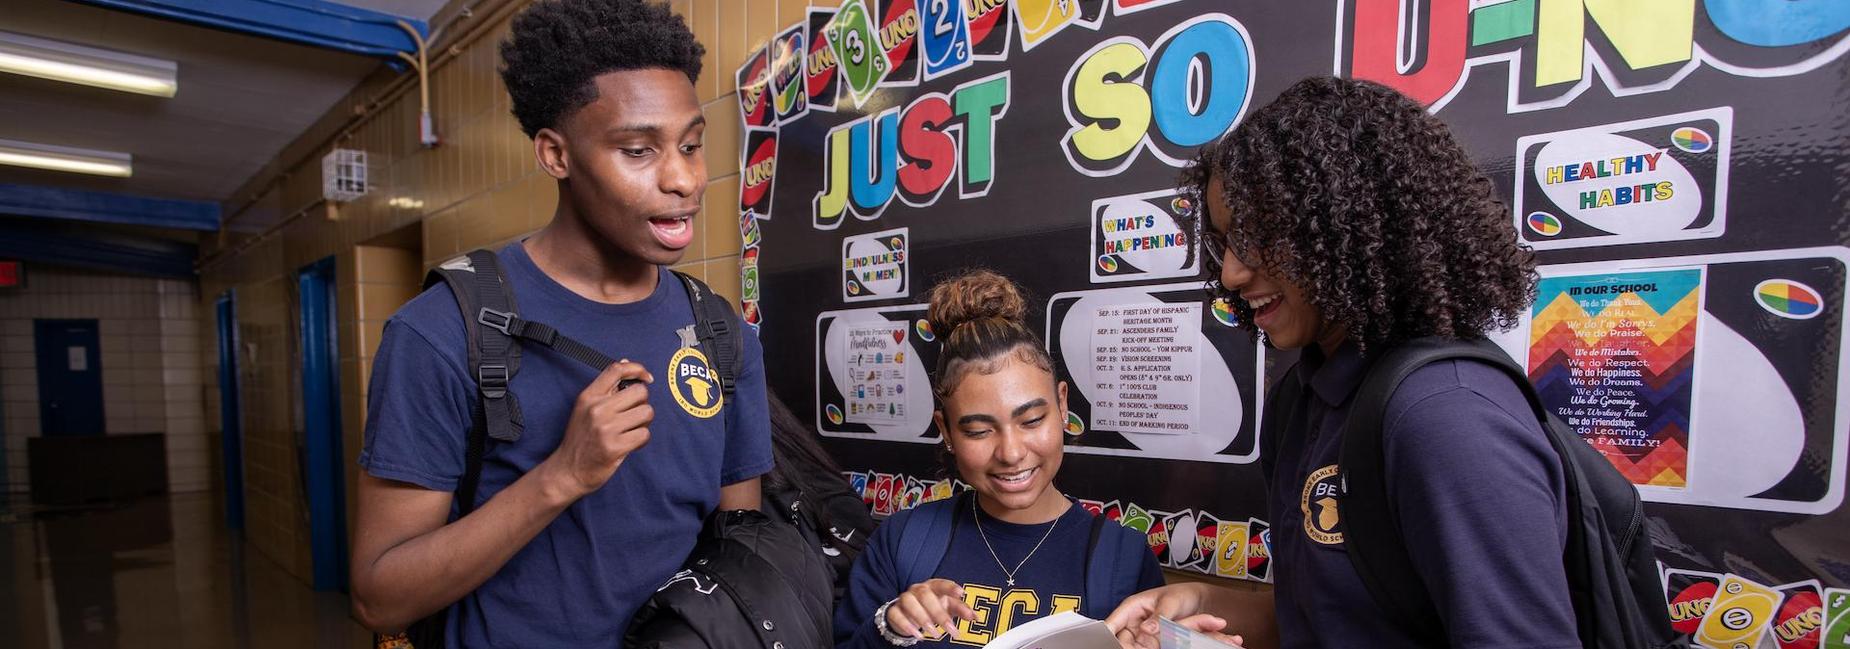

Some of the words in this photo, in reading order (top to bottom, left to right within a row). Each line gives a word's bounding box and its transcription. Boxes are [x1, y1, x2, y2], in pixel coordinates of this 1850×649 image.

[931, 0, 954, 37] 2
[878, 8, 918, 53] UNO
[845, 29, 865, 66] 3
[955, 40, 966, 60] 2
[808, 46, 837, 78] UN
[1072, 18, 1251, 161] SO
[816, 75, 1010, 221] JUST
[743, 155, 776, 188] UNO
[1546, 151, 1662, 185] HEALTHY
[1579, 181, 1674, 211] HABITS
[1104, 214, 1155, 233] WHAT'S
[1105, 232, 1185, 255] HAPPENING
[846, 251, 904, 269] MINDFULNESS
[863, 267, 899, 282] MOMENT
[1584, 285, 1608, 295] OUR
[1610, 283, 1658, 294] SCHOOL
[1567, 320, 1581, 329] We
[1584, 320, 1597, 329] do
[1618, 318, 1656, 331] Sorrys.
[1575, 330, 1591, 338] We
[1610, 329, 1646, 337] Praise.
[1589, 348, 1599, 356] do
[1600, 347, 1642, 356] Mistakes.
[1567, 358, 1585, 367] We
[1588, 358, 1601, 367] do
[1605, 358, 1651, 369] Respect.
[1570, 368, 1583, 376] We
[1584, 368, 1595, 376] do
[1596, 367, 1642, 378] Happiness.
[1569, 378, 1585, 386] We
[1587, 377, 1600, 386] do
[1602, 377, 1643, 386] Dreams.
[1576, 387, 1591, 396] We
[1592, 387, 1605, 396] do
[1607, 388, 1636, 397] Peace.
[1570, 396, 1586, 404] We
[1587, 395, 1598, 405] do
[1599, 395, 1640, 409] Growing.
[1558, 407, 1573, 415] We
[1574, 407, 1585, 416] do
[1586, 408, 1622, 419] Working
[1623, 408, 1649, 418] Hard.
[1568, 417, 1580, 425] We
[1581, 417, 1591, 426] do
[1591, 417, 1637, 428] Friendships.
[1577, 426, 1591, 434] do
[1594, 427, 1649, 439] Learning.
[1597, 437, 1660, 447] FAMILY!
[1774, 605, 1822, 643] UNO
